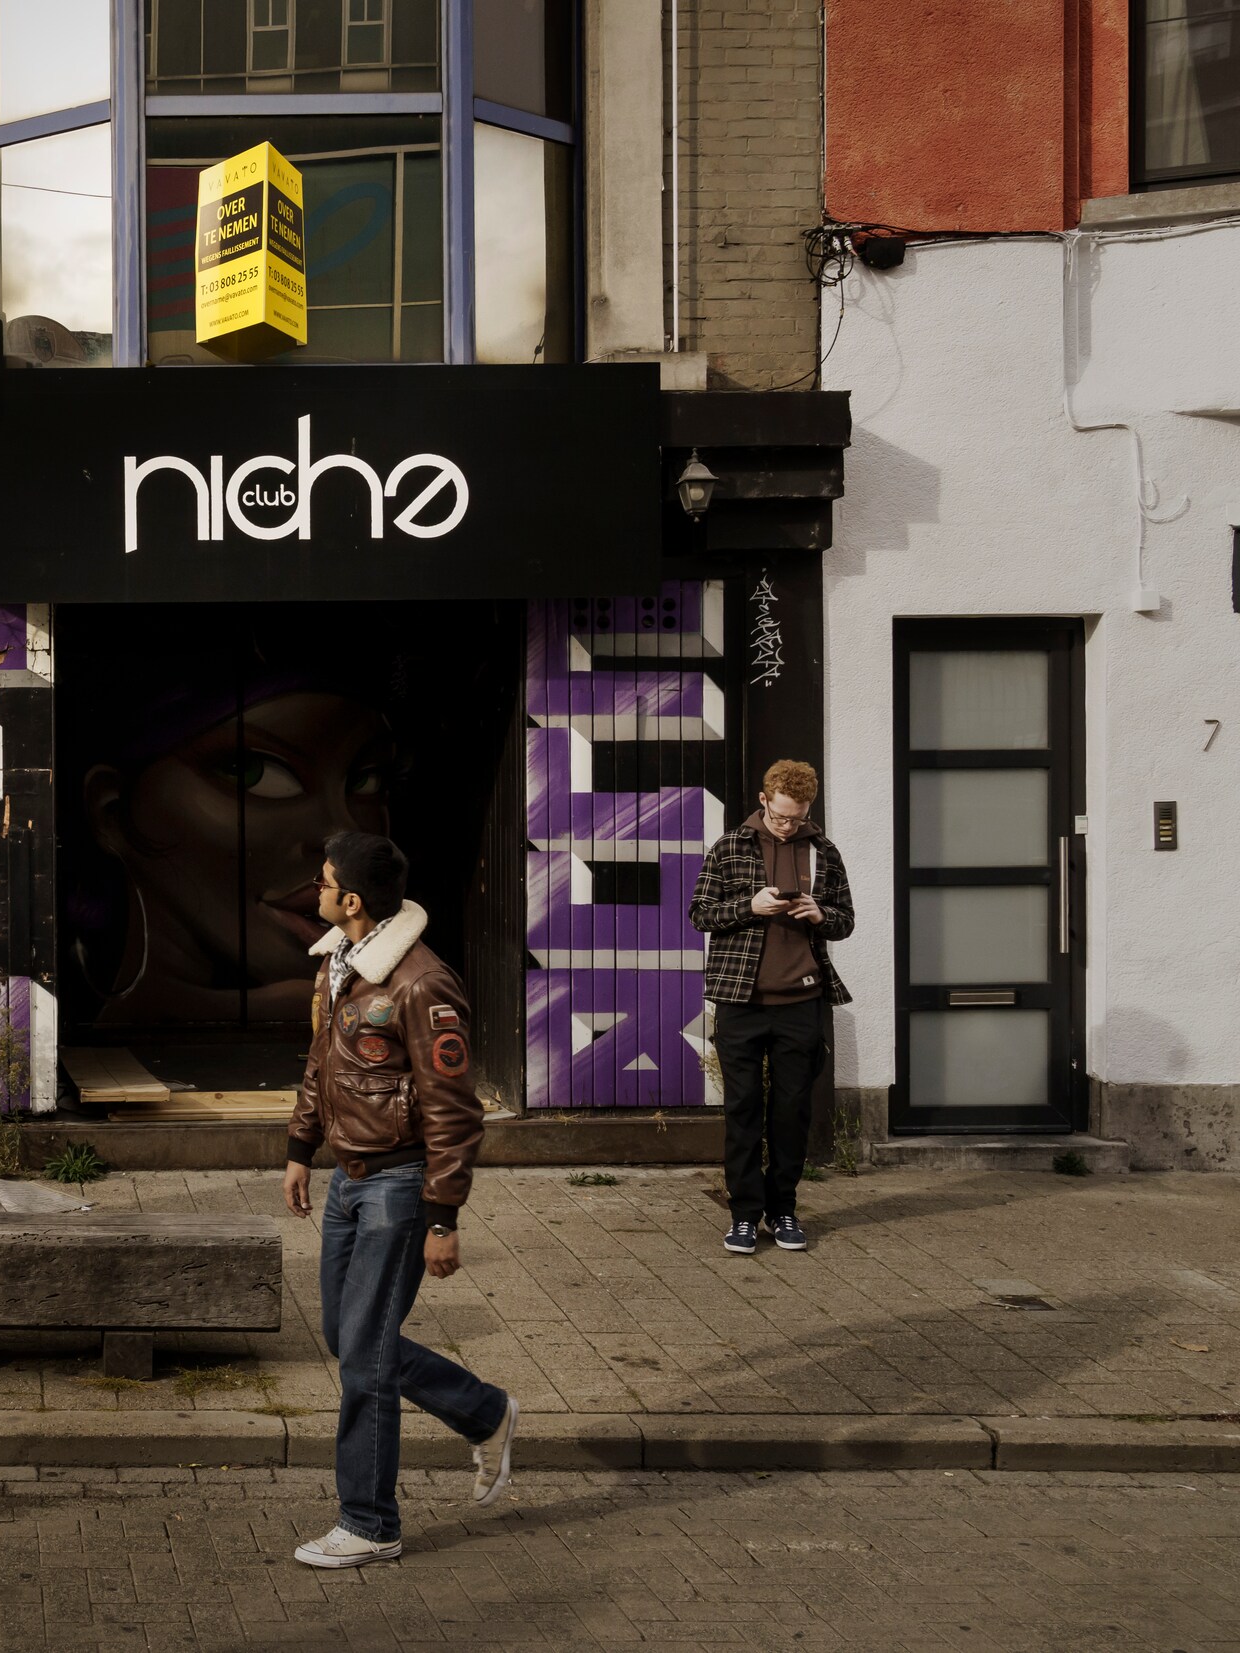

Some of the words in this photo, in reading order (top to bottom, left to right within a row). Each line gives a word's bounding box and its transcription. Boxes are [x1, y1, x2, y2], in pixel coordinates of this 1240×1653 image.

[208, 162, 257, 191] VAVATO
[272, 162, 299, 195] VAVATO
[217, 197, 245, 220] OVER
[277, 200, 294, 224] OVER
[203, 229, 217, 246] TE
[218, 213, 258, 241] NEMEN
[270, 214, 279, 233] TE
[278, 221, 301, 250] NEMEN
[201, 251, 222, 265] WEGENS
[221, 236, 259, 257] FAILLISSEMENT
[201, 284, 208, 295] T:
[209, 280, 219, 292] 03
[220, 274, 236, 289] 808
[237, 270, 247, 283] 25
[248, 266, 259, 279] 55
[268, 266, 274, 279] T:
[273, 269, 280, 283] 03
[280, 274, 291, 290] 808
[297, 285, 304, 297] 55
[242, 484, 296, 507] club
[1203, 719, 1220, 752] 7
